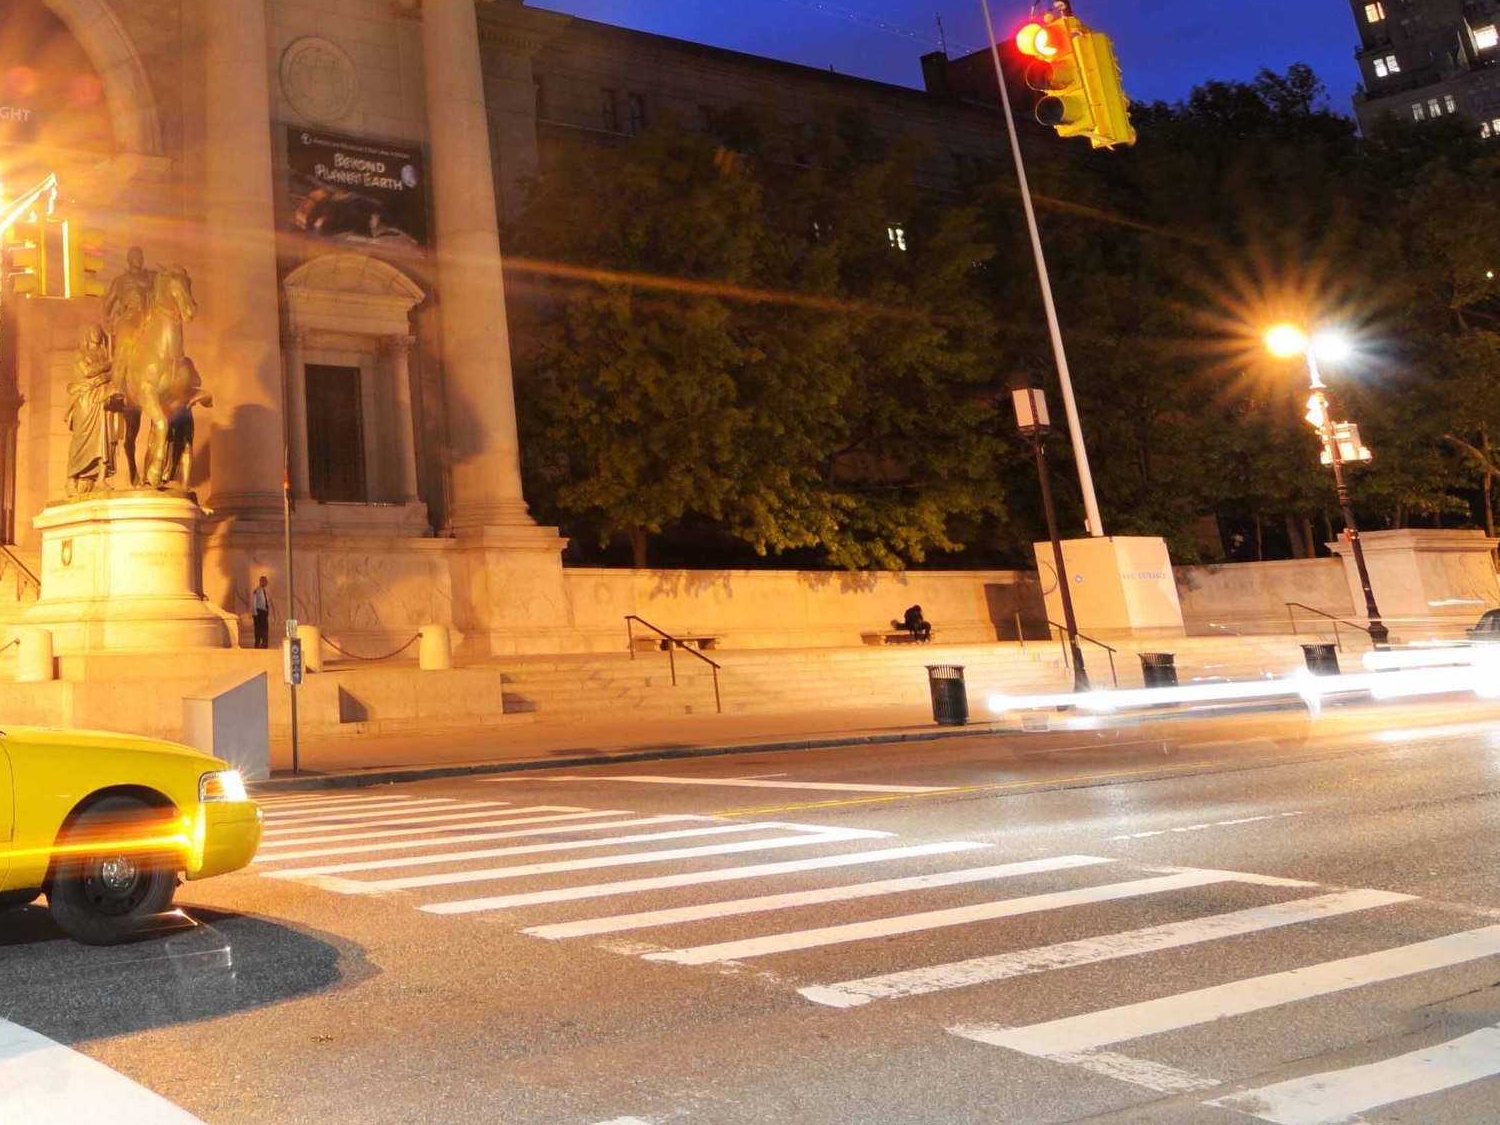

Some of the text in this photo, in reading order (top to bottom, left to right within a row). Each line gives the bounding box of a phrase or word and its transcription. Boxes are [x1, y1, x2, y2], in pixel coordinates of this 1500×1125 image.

[333, 153, 386, 173] BEYOND
[314, 163, 404, 191] PLANET EARTH
